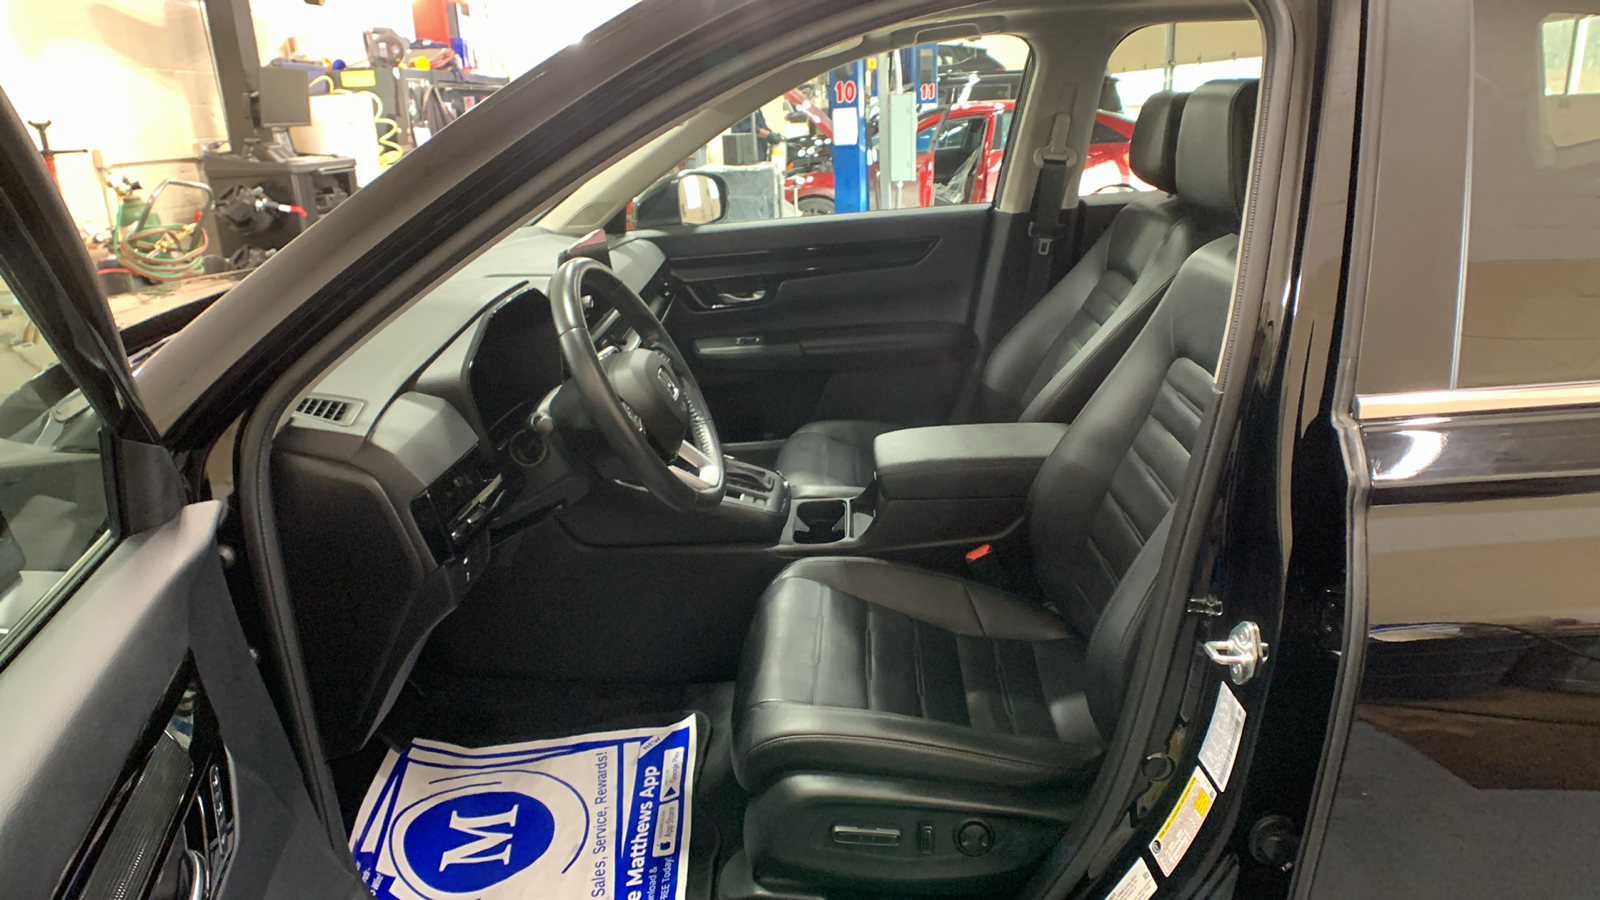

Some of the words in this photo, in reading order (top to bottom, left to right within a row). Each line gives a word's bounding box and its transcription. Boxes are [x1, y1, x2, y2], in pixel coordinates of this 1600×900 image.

[834, 80, 856, 103] 10
[920, 83, 935, 100] 11
[643, 736, 661, 750] NEW
[594, 751, 608, 805] Rewards!
[669, 762, 680, 784] Google
[625, 801, 653, 887] Matthews
[639, 766, 660, 798] App
[665, 806, 675, 825] Store
[439, 803, 519, 872] M
[592, 806, 609, 855] Service,
[664, 825, 675, 837] App
[591, 856, 608, 897] Sales,
[648, 866, 658, 874] &
[661, 857, 674, 884] Today!
